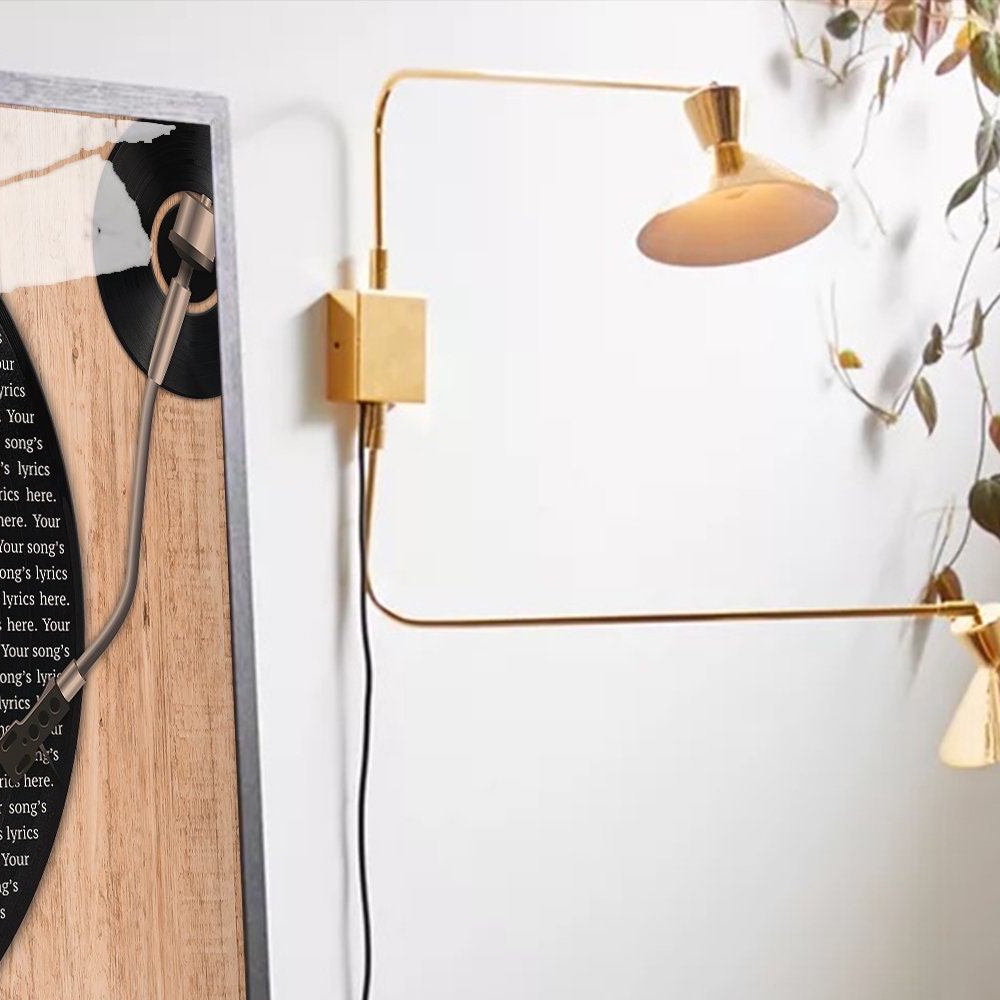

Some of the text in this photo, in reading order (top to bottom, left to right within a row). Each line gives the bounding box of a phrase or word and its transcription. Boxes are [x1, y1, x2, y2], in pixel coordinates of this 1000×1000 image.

[6, 409, 35, 424] Your
[5, 437, 43, 453] song's
[17, 461, 50, 479] lyrics
[32, 514, 61, 528] Your
[27, 541, 65, 557] song's
[36, 565, 68, 583] lyrics
[7, 617, 38, 631] here.
[42, 618, 70, 632] Your
[1, 644, 29, 657] Your
[33, 644, 70, 661] song's
[9, 800, 47, 817] song's
